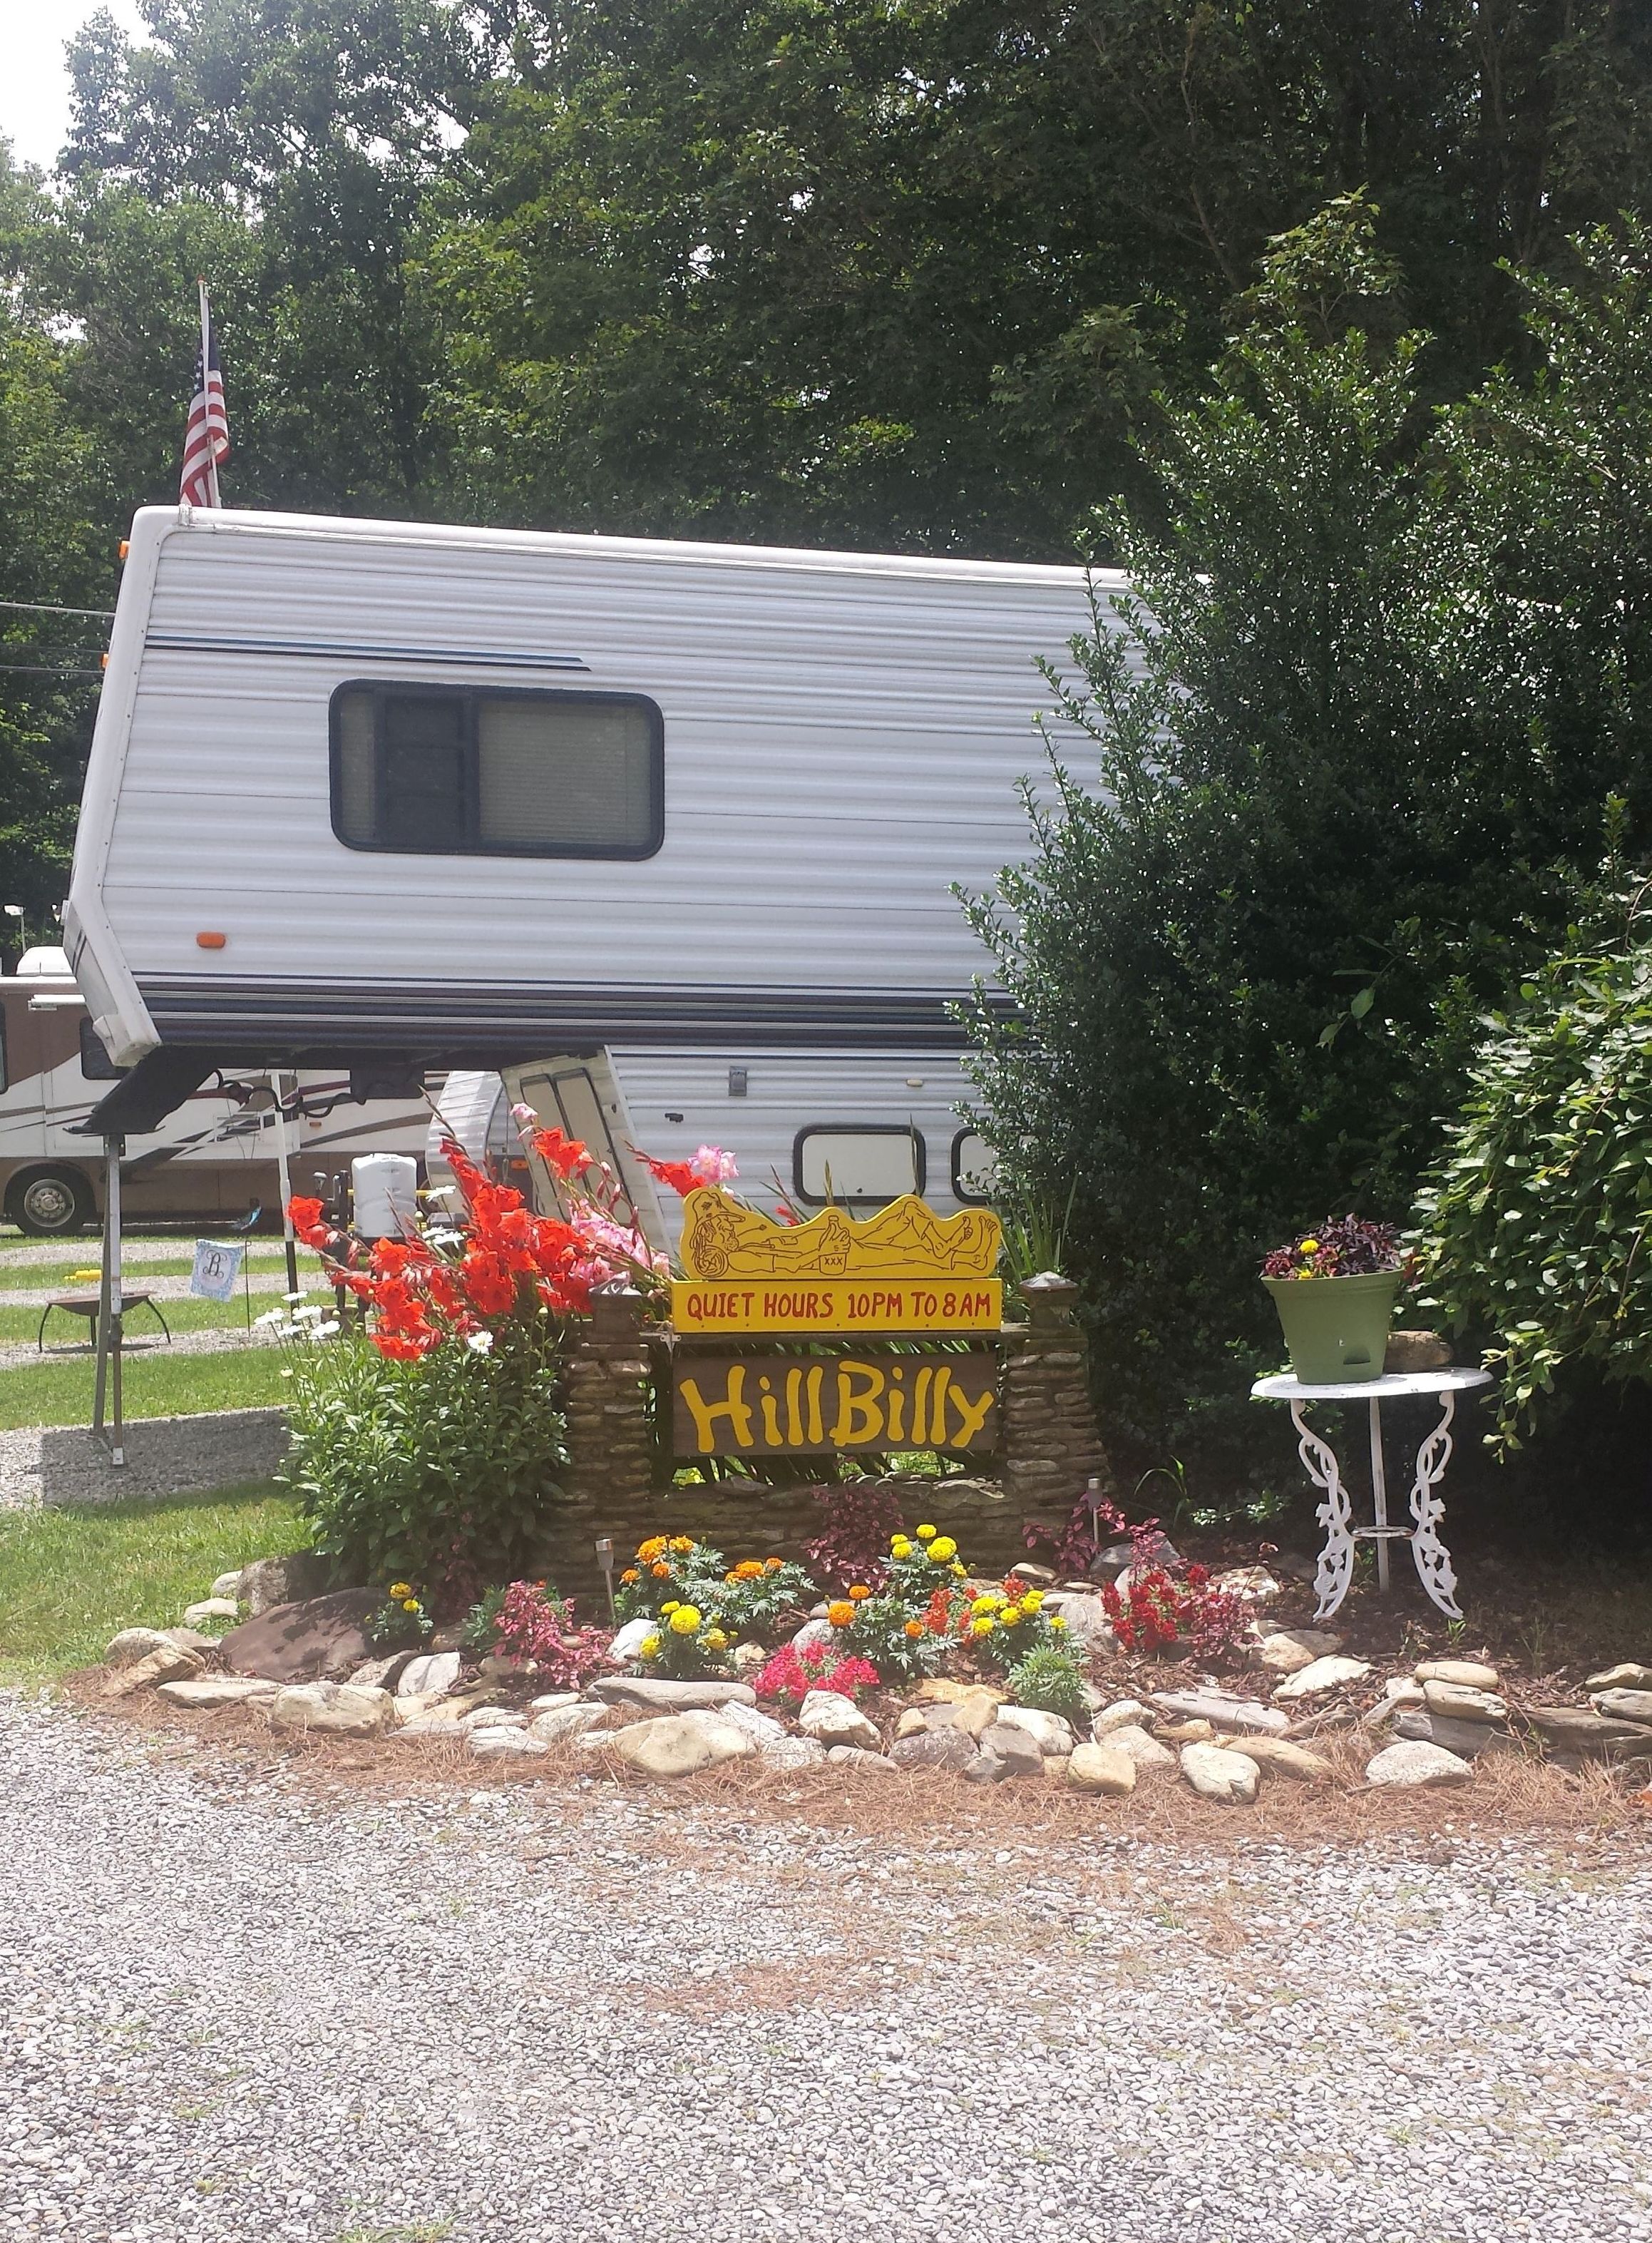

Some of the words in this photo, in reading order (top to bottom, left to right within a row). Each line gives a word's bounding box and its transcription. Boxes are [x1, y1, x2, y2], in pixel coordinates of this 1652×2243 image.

[824, 1257, 843, 1266] XXX
[687, 1292, 755, 1320] QUIET
[764, 1292, 833, 1319] HOURS
[848, 1292, 903, 1319] 10PM
[910, 1292, 938, 1318] TO
[679, 1360, 995, 1453] HillBilly
